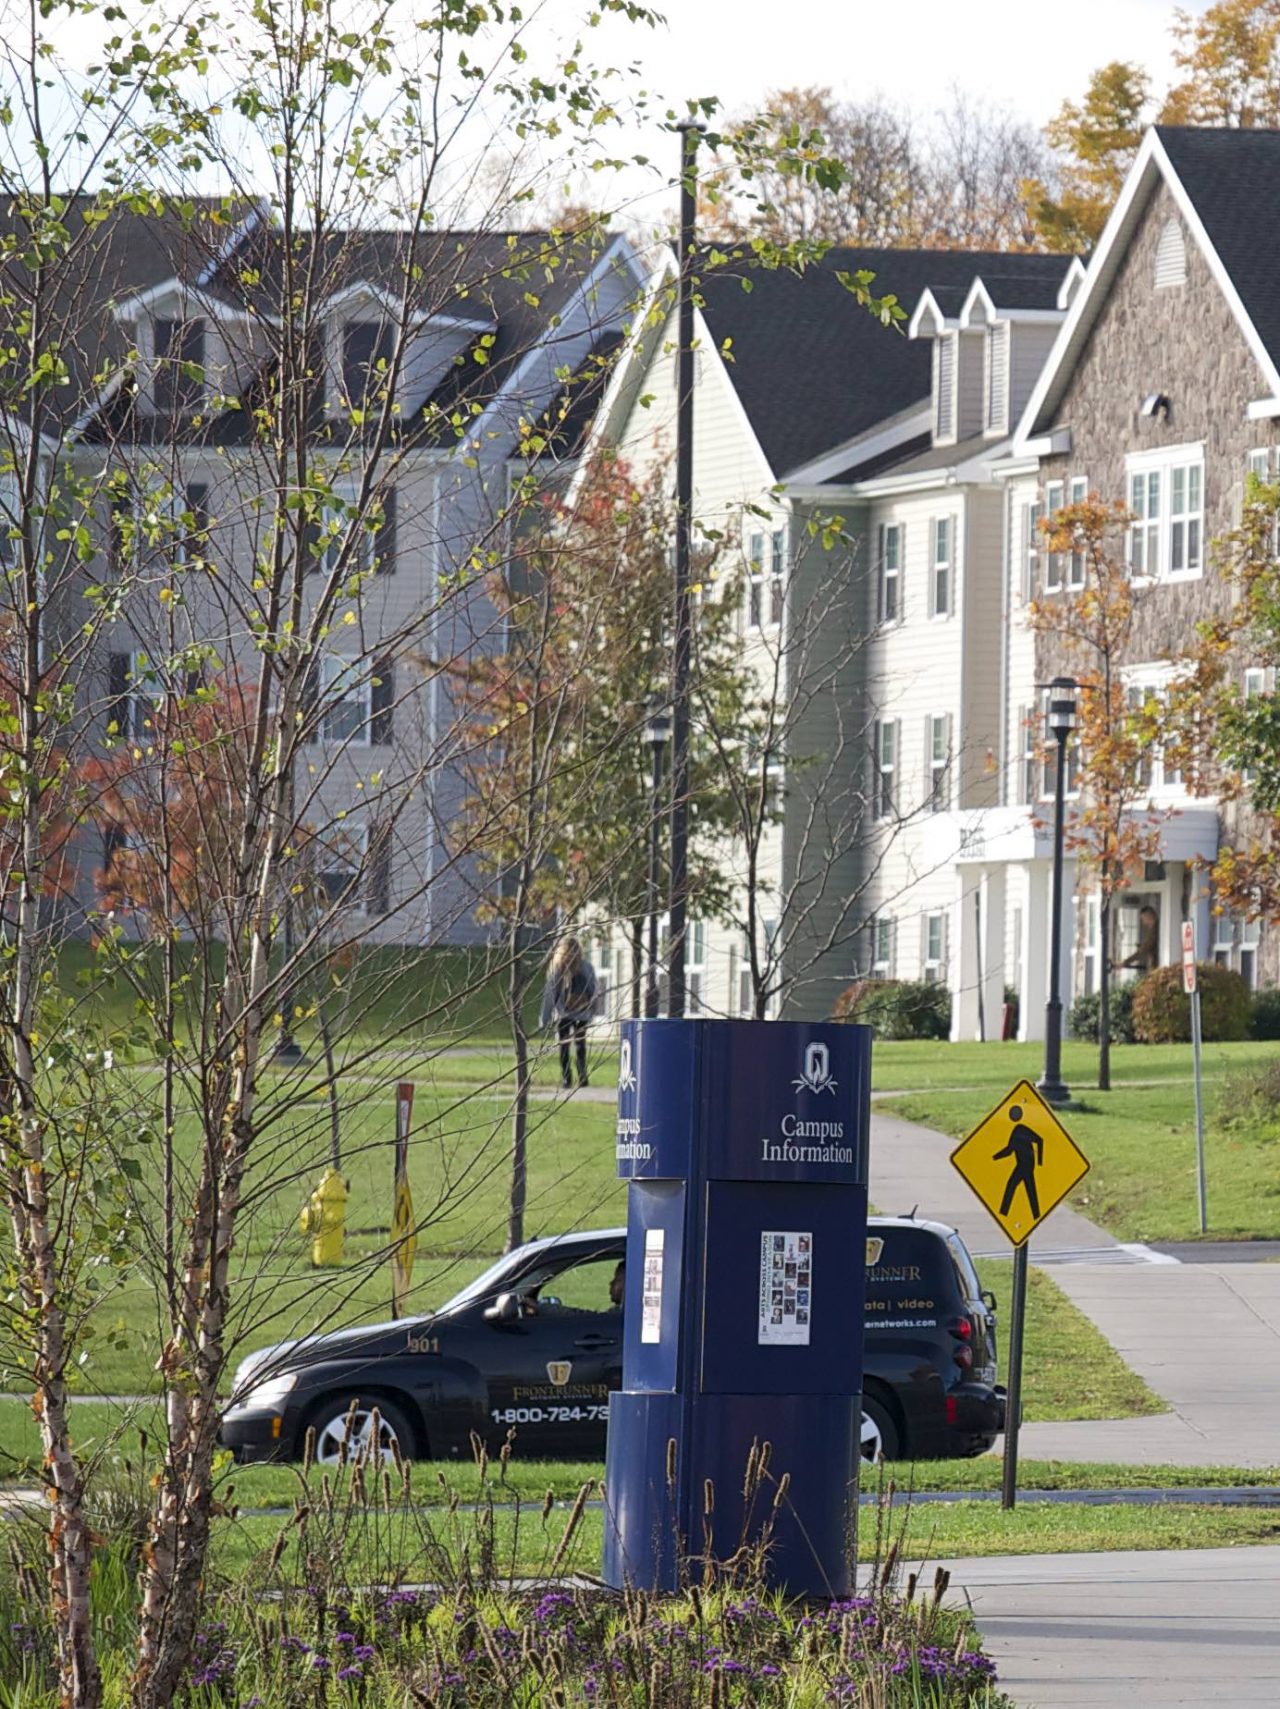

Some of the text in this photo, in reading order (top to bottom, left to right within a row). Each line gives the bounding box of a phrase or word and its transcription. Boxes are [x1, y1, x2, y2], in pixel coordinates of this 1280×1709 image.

[781, 1114, 844, 1144] Campus
[761, 1138, 853, 1163] Information
[896, 1299, 935, 1309] video
[410, 1338, 439, 1353] 901
[513, 1384, 608, 1401] FRONTRUNNER
